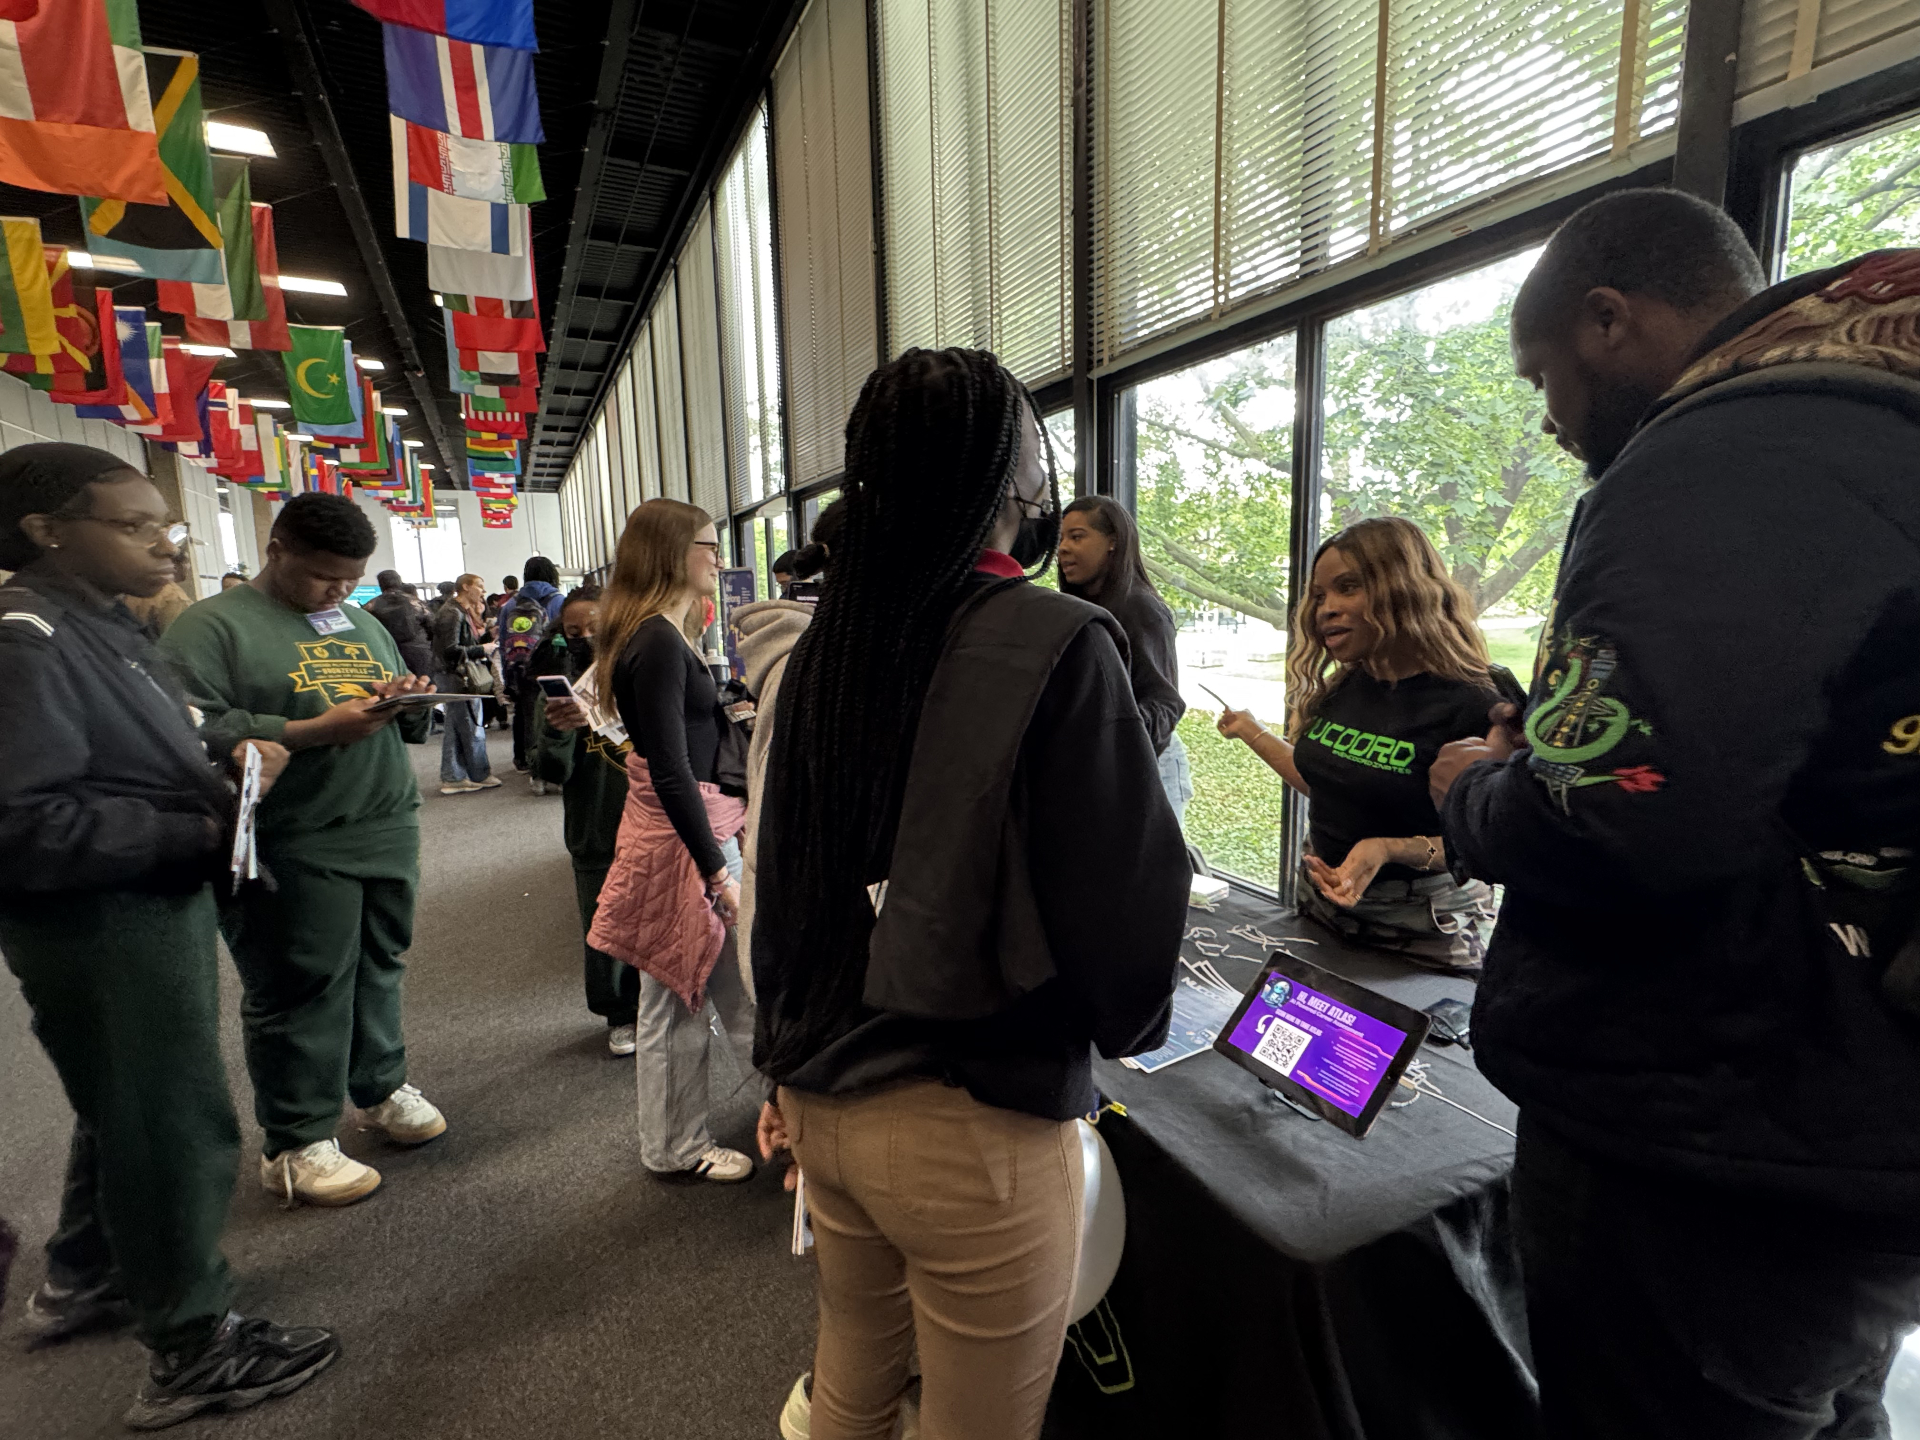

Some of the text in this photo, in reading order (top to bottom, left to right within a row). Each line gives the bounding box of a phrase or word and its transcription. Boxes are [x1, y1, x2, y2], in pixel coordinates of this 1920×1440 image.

[321, 667, 368, 675] BRONZEVILLE
[1307, 996, 1331, 1013] MEET
[1327, 1006, 1357, 1026] ATLAS!
